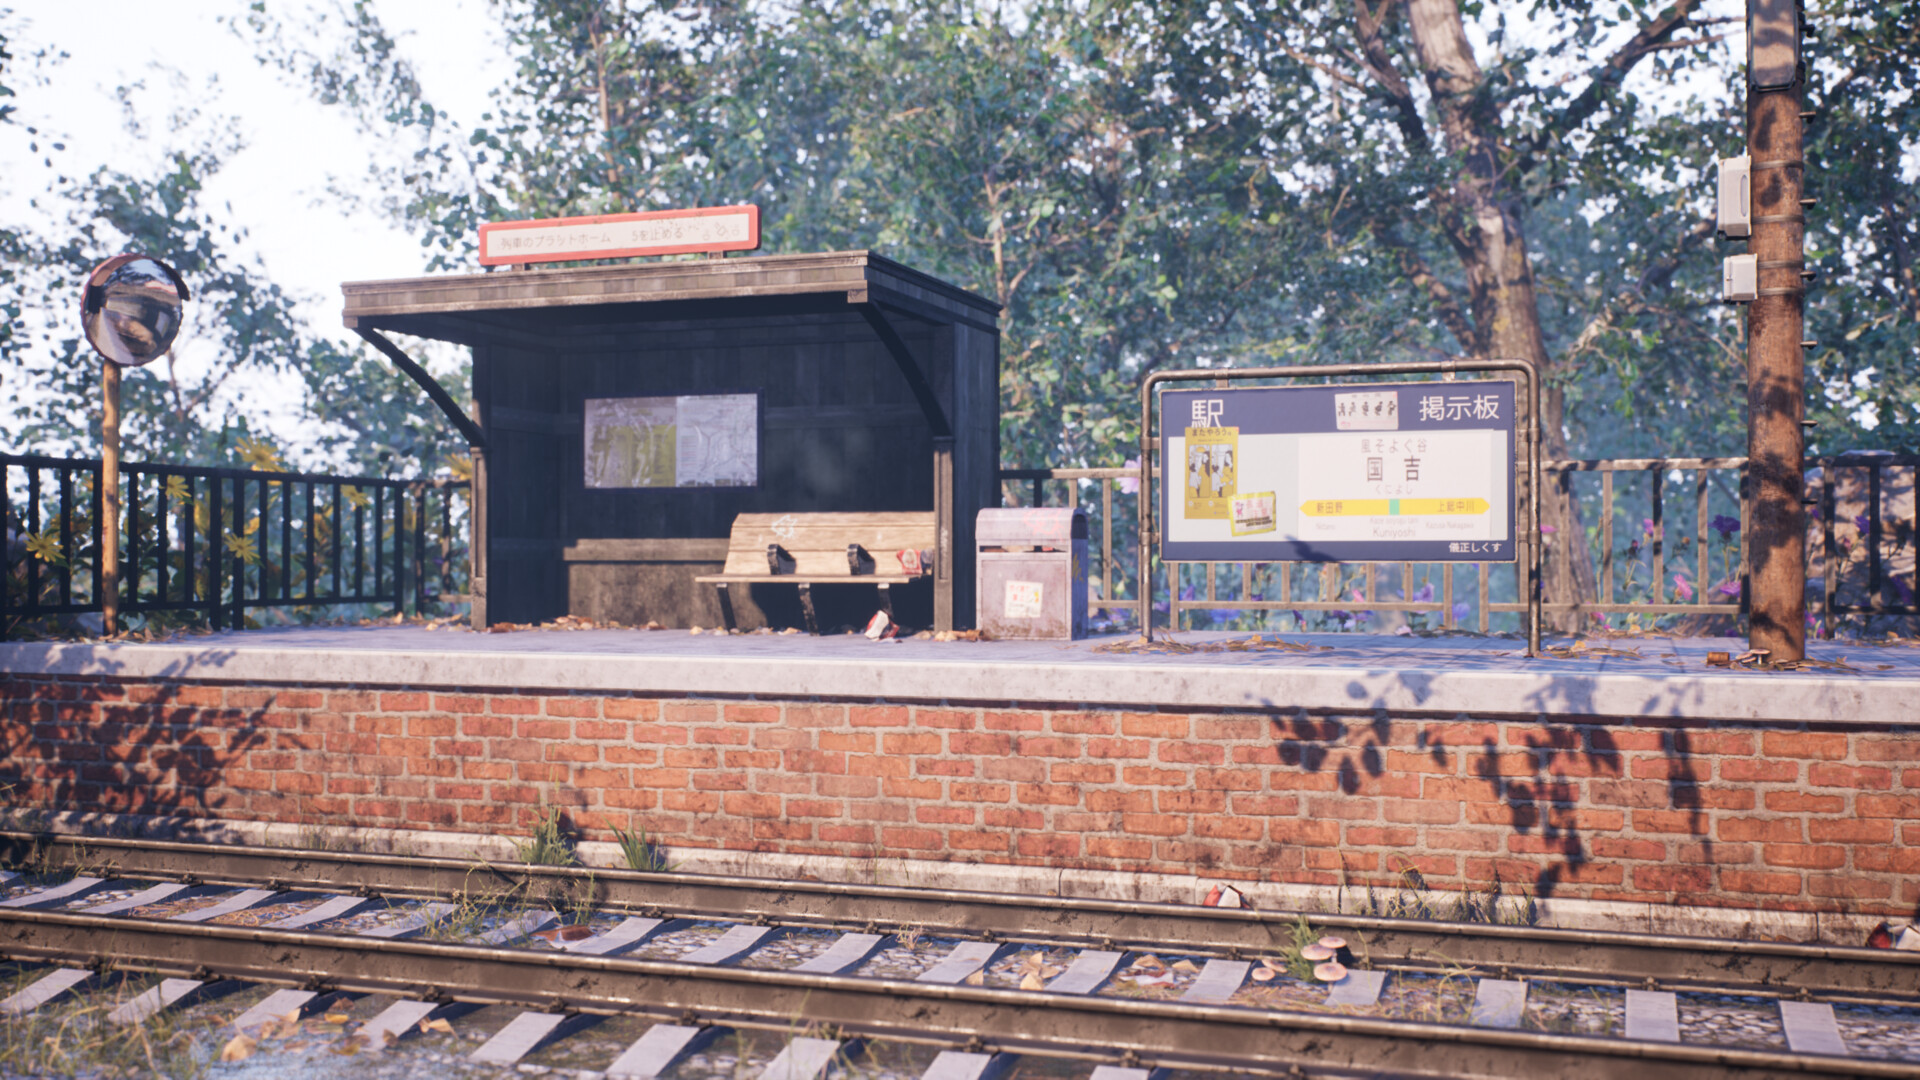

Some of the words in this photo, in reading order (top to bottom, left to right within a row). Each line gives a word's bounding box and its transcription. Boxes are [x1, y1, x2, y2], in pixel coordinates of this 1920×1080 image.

[1191, 399, 1224, 428] 駅
[1419, 395, 1500, 422] 掲示板
[1373, 526, 1416, 538] Kuniyoshi
